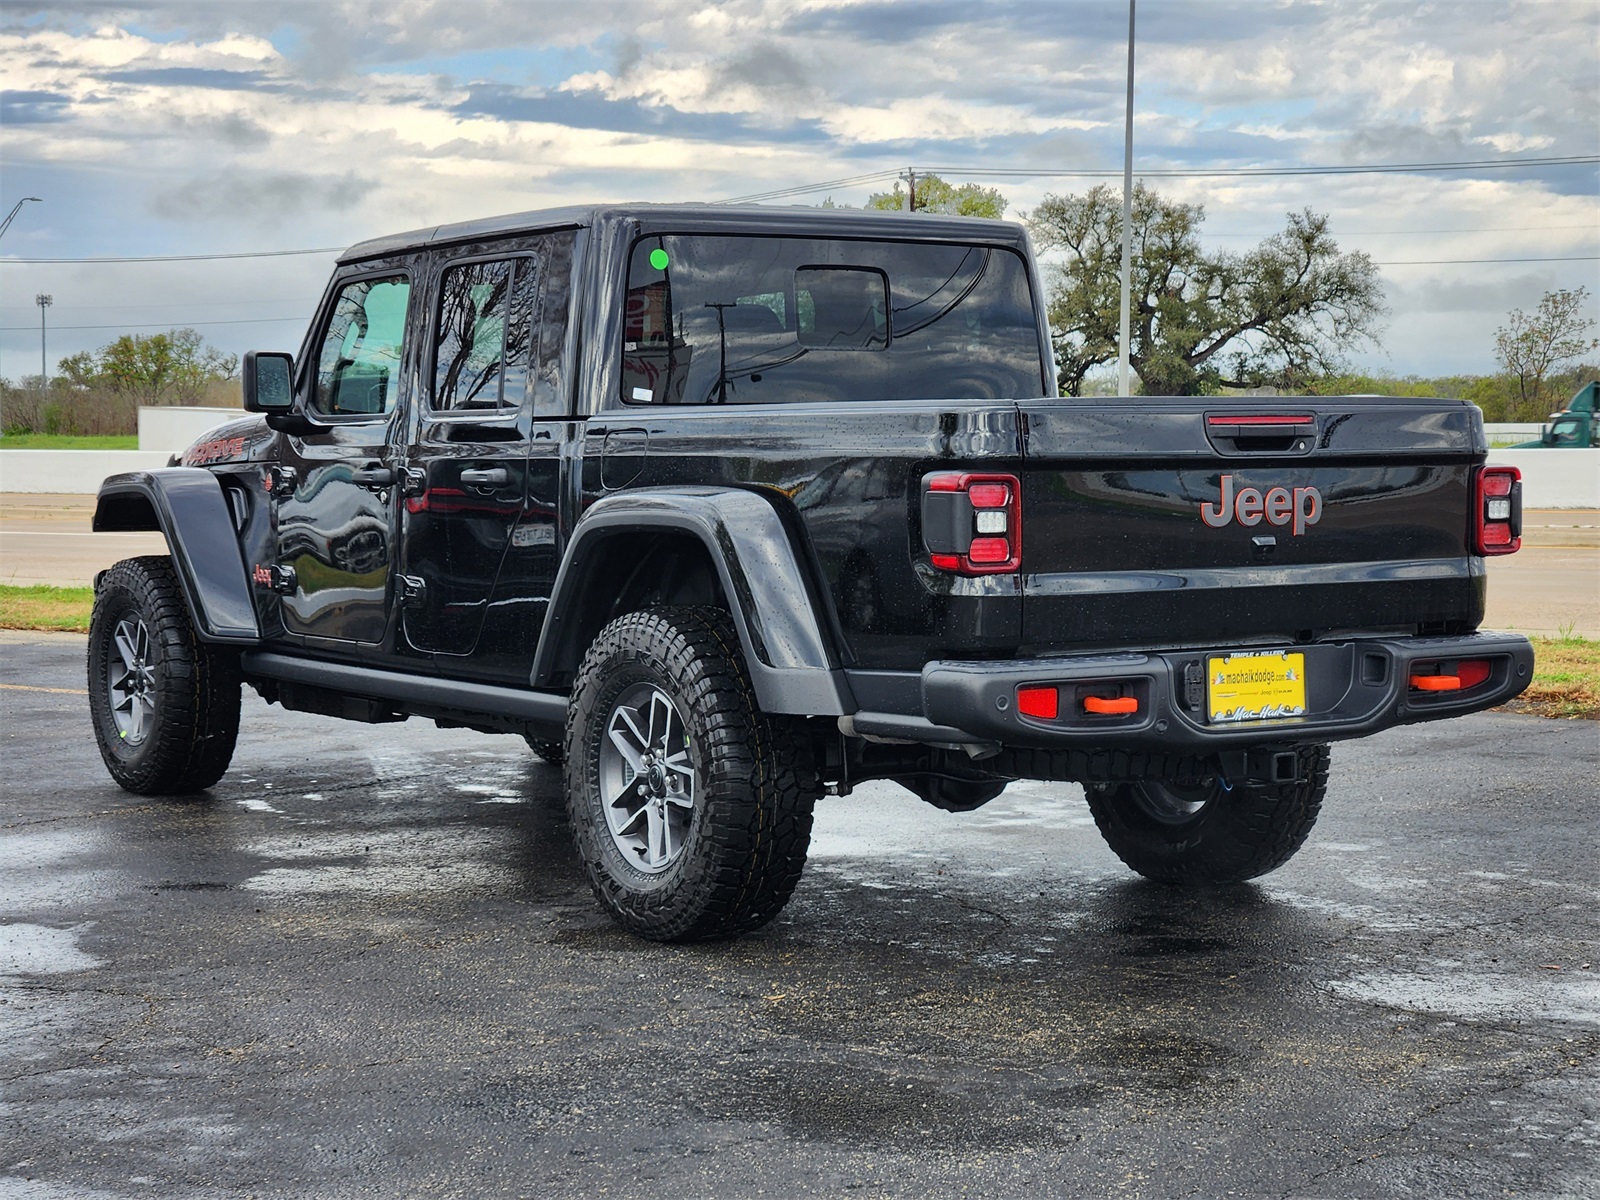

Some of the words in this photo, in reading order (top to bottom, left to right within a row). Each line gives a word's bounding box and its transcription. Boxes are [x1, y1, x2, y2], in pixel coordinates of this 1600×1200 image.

[1200, 474, 1323, 537] Jeep
[253, 563, 272, 588] Jeep
[1226, 669, 1285, 685] machaikdodge.com
[1234, 706, 1255, 721] Mac
[1259, 703, 1287, 719] Haik
